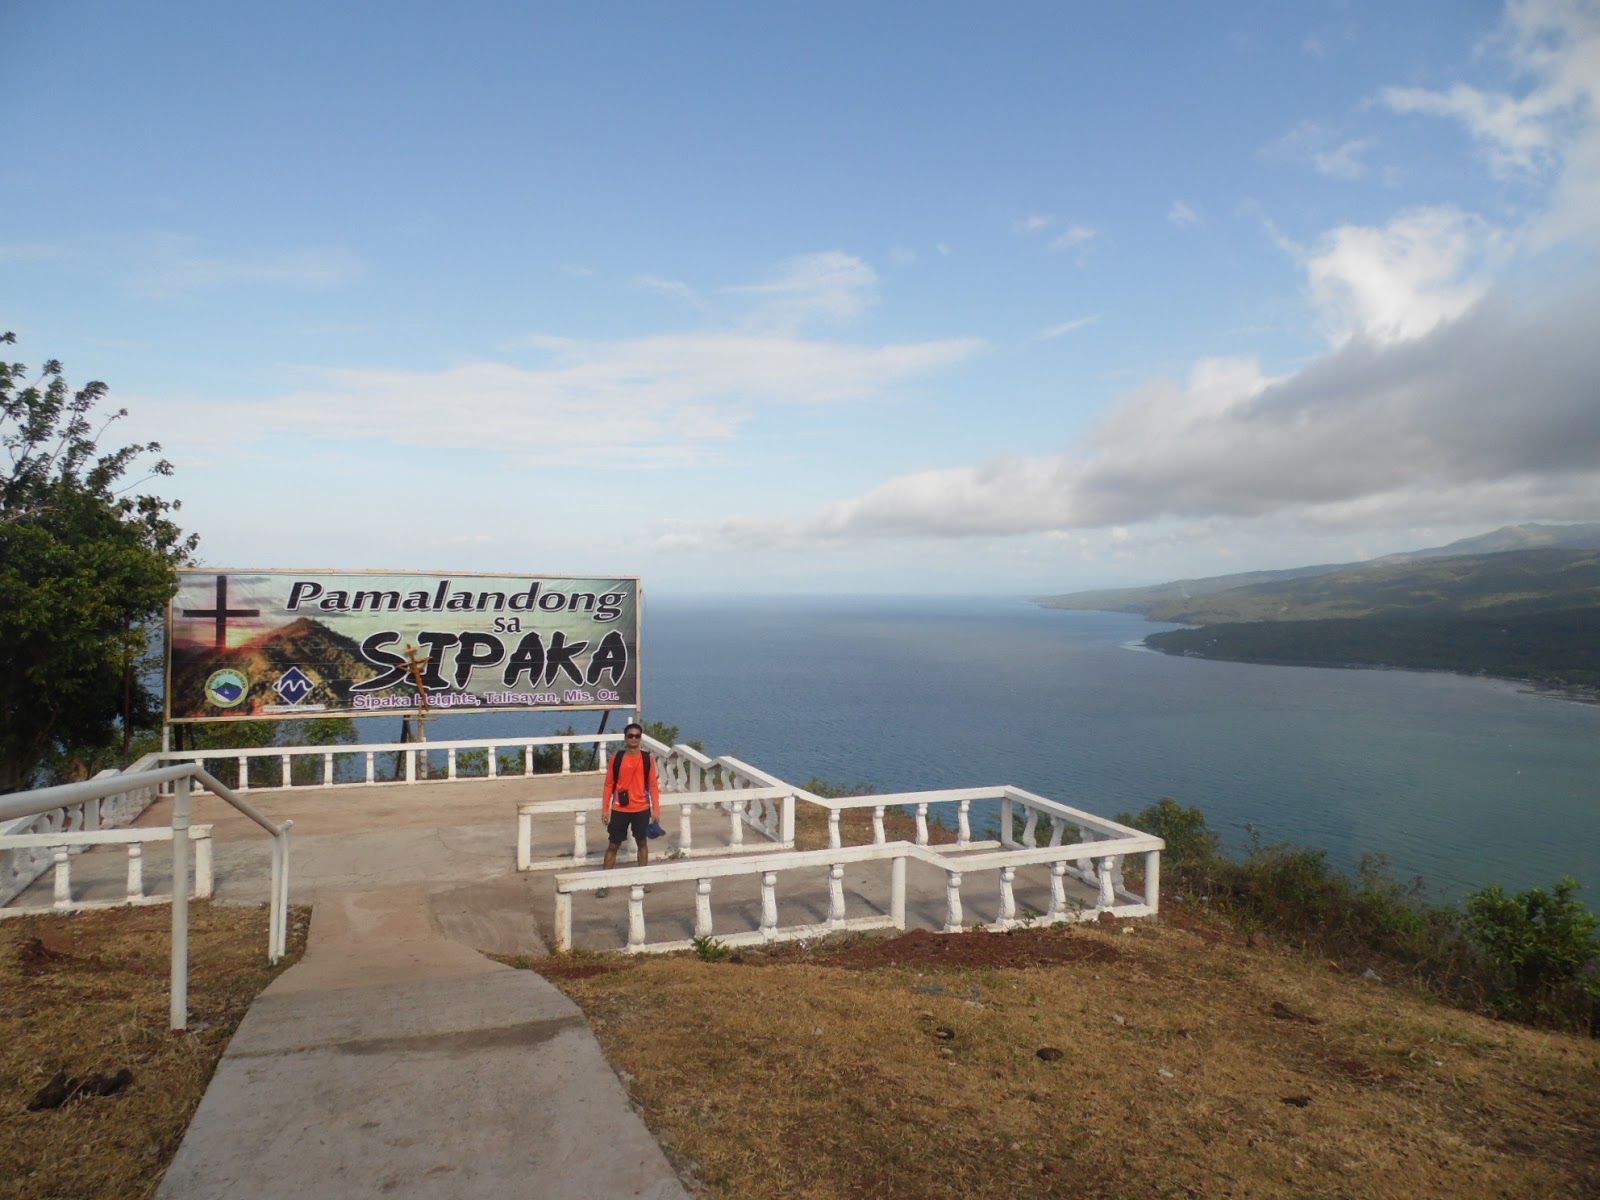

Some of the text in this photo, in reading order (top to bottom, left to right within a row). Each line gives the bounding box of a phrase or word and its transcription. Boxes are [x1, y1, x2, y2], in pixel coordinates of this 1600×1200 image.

[286, 580, 627, 622] Pamalandong
[494, 615, 522, 634] sa
[349, 629, 628, 692] SIPAKA
[353, 694, 411, 710] Sipaka
[484, 691, 561, 705] Talisayan,
[564, 689, 595, 701] Mis.
[597, 688, 620, 701] Or.
